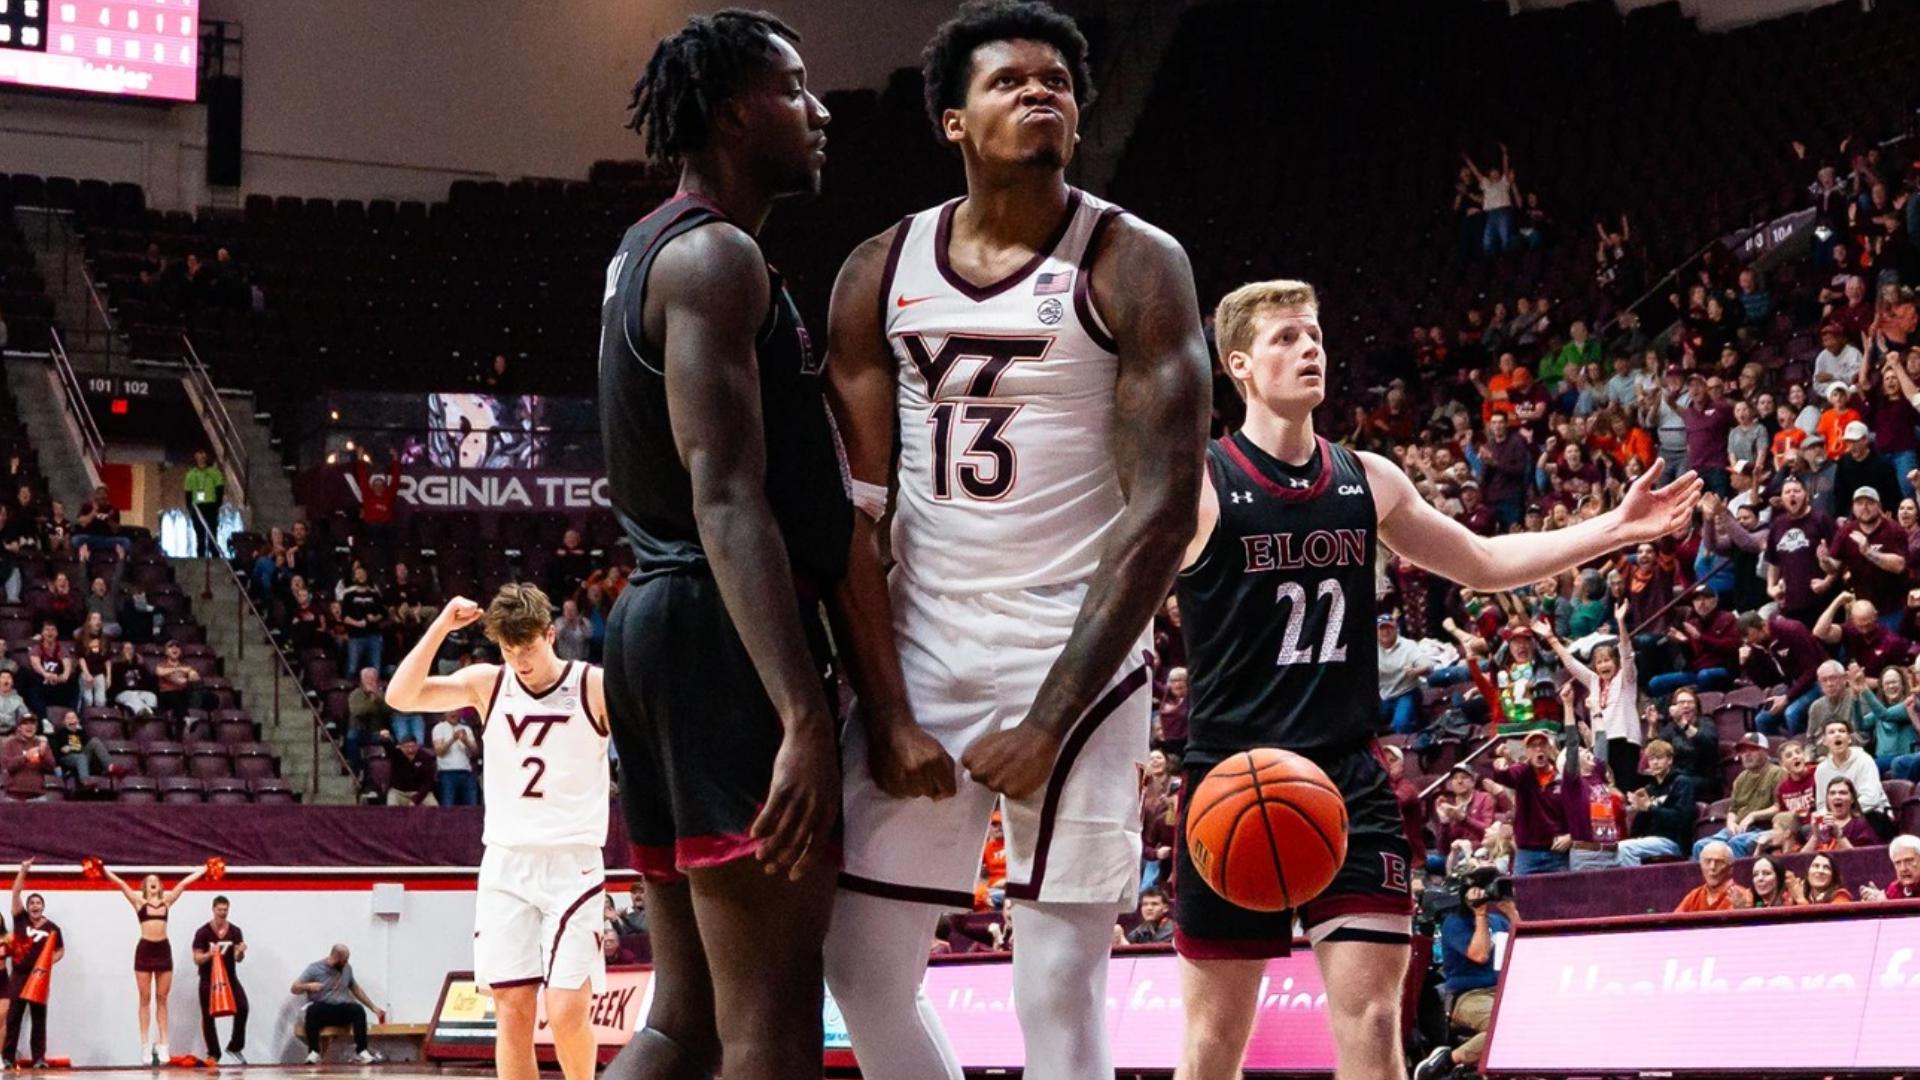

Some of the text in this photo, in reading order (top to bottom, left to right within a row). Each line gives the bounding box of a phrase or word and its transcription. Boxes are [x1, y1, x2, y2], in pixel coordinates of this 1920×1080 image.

[88, 379, 149, 395] 101 102
[897, 332, 1056, 400] VT
[926, 401, 1025, 501] 13
[1337, 484, 1364, 496] CAA
[1240, 529, 1367, 573] ELON
[1275, 578, 1348, 666] 22
[504, 713, 571, 748] VT
[520, 757, 546, 799] 2
[1379, 851, 1408, 893] E
[26, 926, 49, 943] VT
